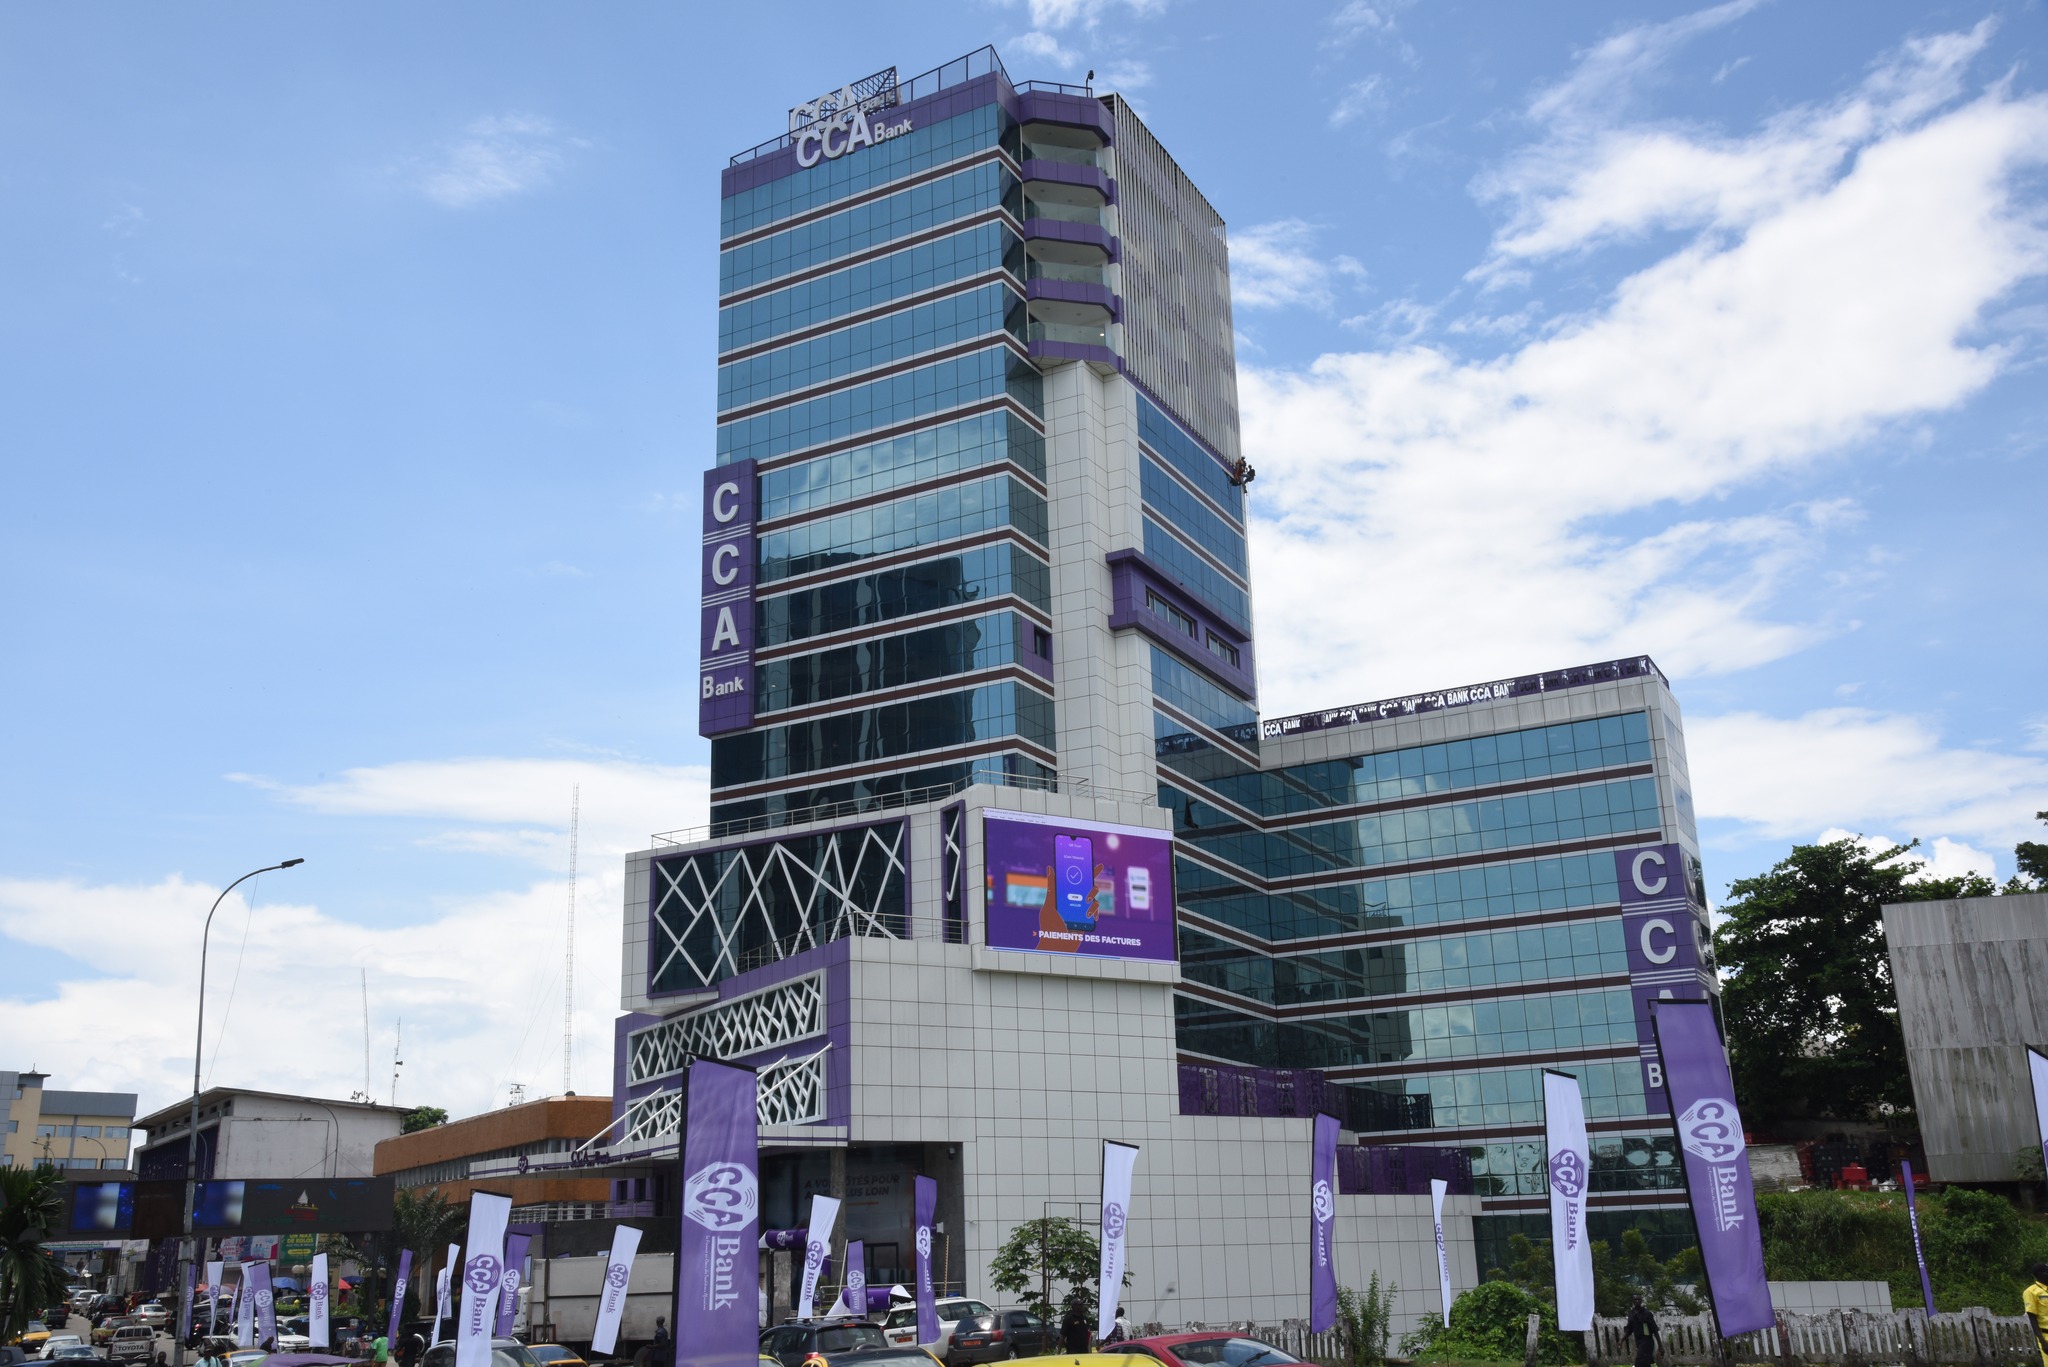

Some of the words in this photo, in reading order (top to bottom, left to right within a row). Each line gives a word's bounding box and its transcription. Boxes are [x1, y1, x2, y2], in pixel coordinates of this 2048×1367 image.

[797, 109, 875, 168] CCA
[874, 119, 913, 143] Bank
[703, 676, 744, 700] Bank
[1264, 722, 1281, 736] CCA
[1447, 690, 1469, 705] BANK
[1470, 686, 1491, 700] CCA
[1039, 930, 1083, 942] PAIEMENTS
[1085, 934, 1100, 943] DES
[1102, 936, 1141, 946] FACTURES
[571, 1150, 588, 1163] CCA
[1691, 1102, 1735, 1159] CCA
[1717, 1164, 1744, 1231] Bank
[846, 1188, 864, 1197] LUS
[865, 1186, 890, 1197] LOIN
[871, 1174, 900, 1185] POUR
[695, 1167, 743, 1227] CCA
[1314, 1183, 1327, 1220] CCA
[1555, 1152, 1579, 1195] CCA
[1568, 1202, 1579, 1250] Bank
[806, 1243, 821, 1269] CCA
[1106, 1242, 1115, 1279] Bank
[470, 1256, 493, 1292] CCA
[504, 1270, 516, 1291] CCA
[609, 1265, 624, 1286] CCA
[714, 1236, 741, 1310] Bank
[312, 1283, 327, 1300] CCA
[806, 1272, 815, 1301] Bank
[315, 1301, 324, 1320] Bank
[504, 1293, 514, 1316] Bank
[608, 1289, 620, 1313] Bank
[473, 1297, 487, 1336] Bank
